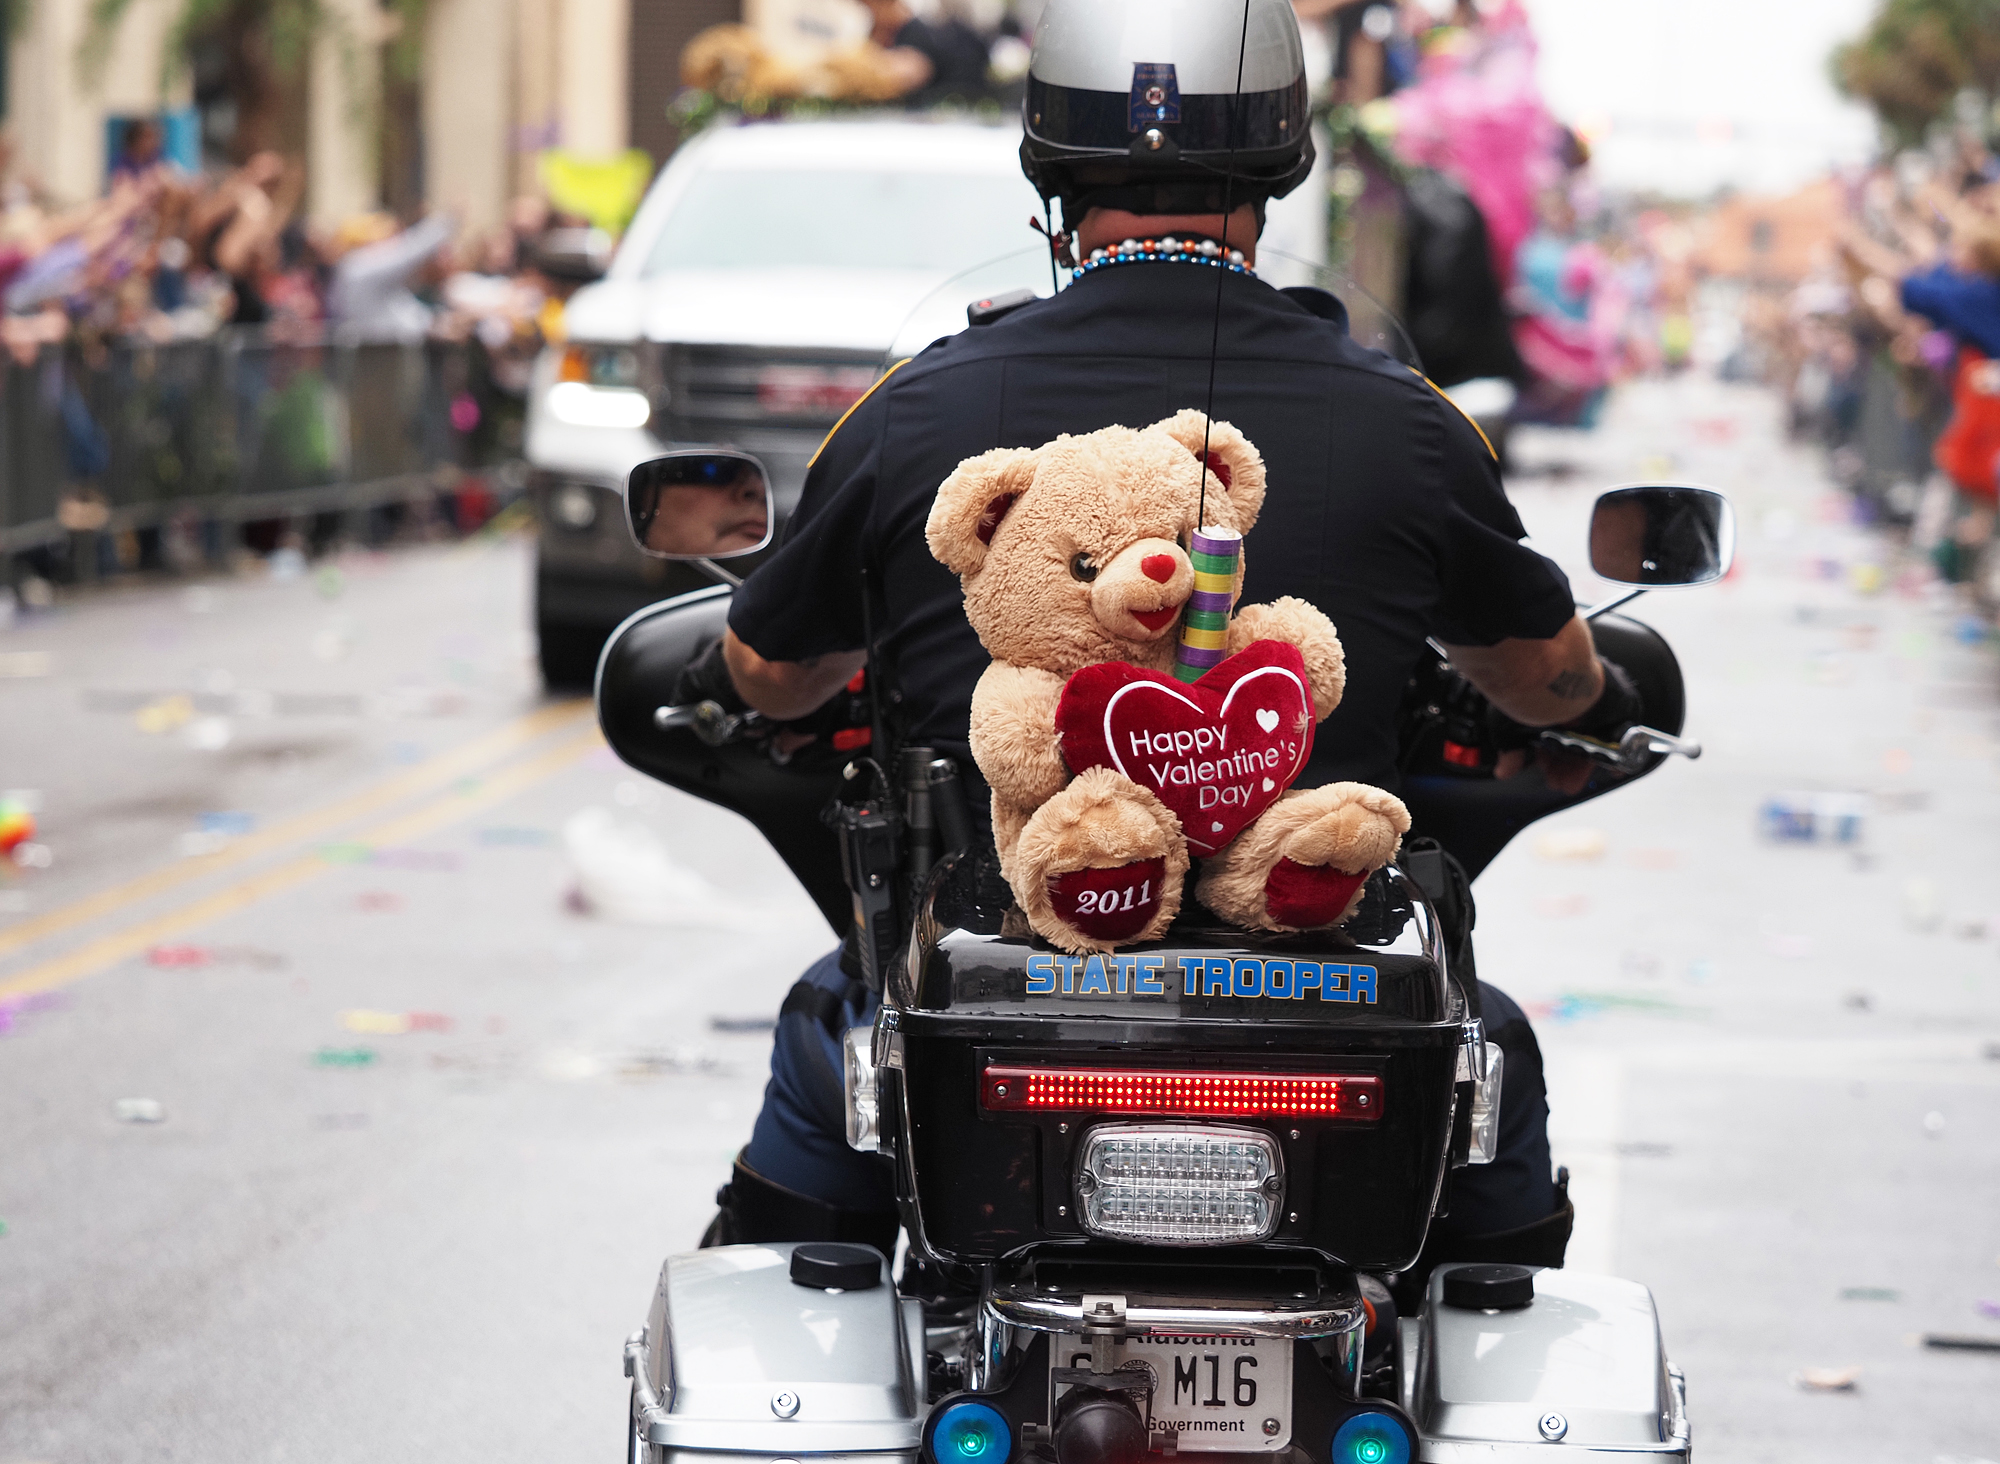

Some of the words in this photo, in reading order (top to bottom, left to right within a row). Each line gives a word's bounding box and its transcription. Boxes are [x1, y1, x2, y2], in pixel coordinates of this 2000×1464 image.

[1129, 724, 1227, 757] Happy
[1148, 739, 1296, 788] Valentine's
[1199, 783, 1254, 810] Day
[1075, 879, 1152, 915] 2011
[1026, 954, 1165, 995] STATE
[1178, 955, 1378, 1005] TROOPER
[1129, 1336, 1255, 1347] abama
[1174, 1355, 1258, 1407] M16
[1148, 1416, 1245, 1432] Government
